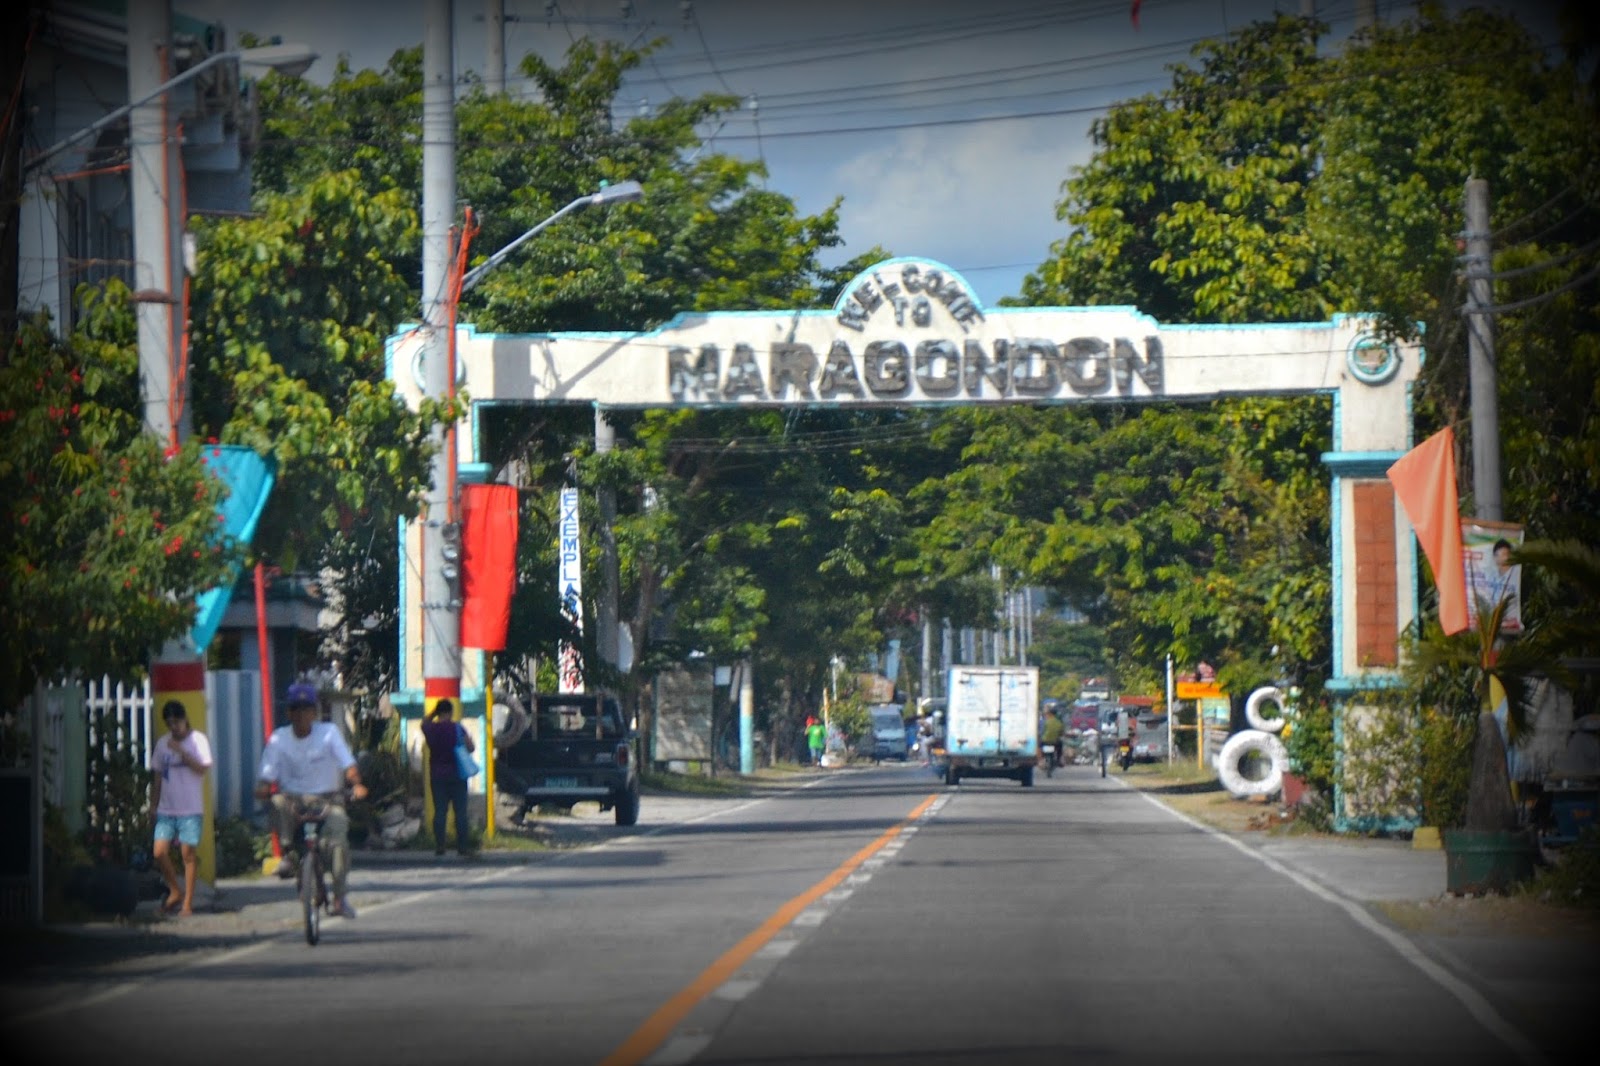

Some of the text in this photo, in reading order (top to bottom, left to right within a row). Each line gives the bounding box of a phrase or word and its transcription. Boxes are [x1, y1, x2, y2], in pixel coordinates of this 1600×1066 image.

[838, 263, 985, 333] WELCOME
[892, 295, 932, 328] TO
[668, 337, 1165, 400] MARAGONDON
